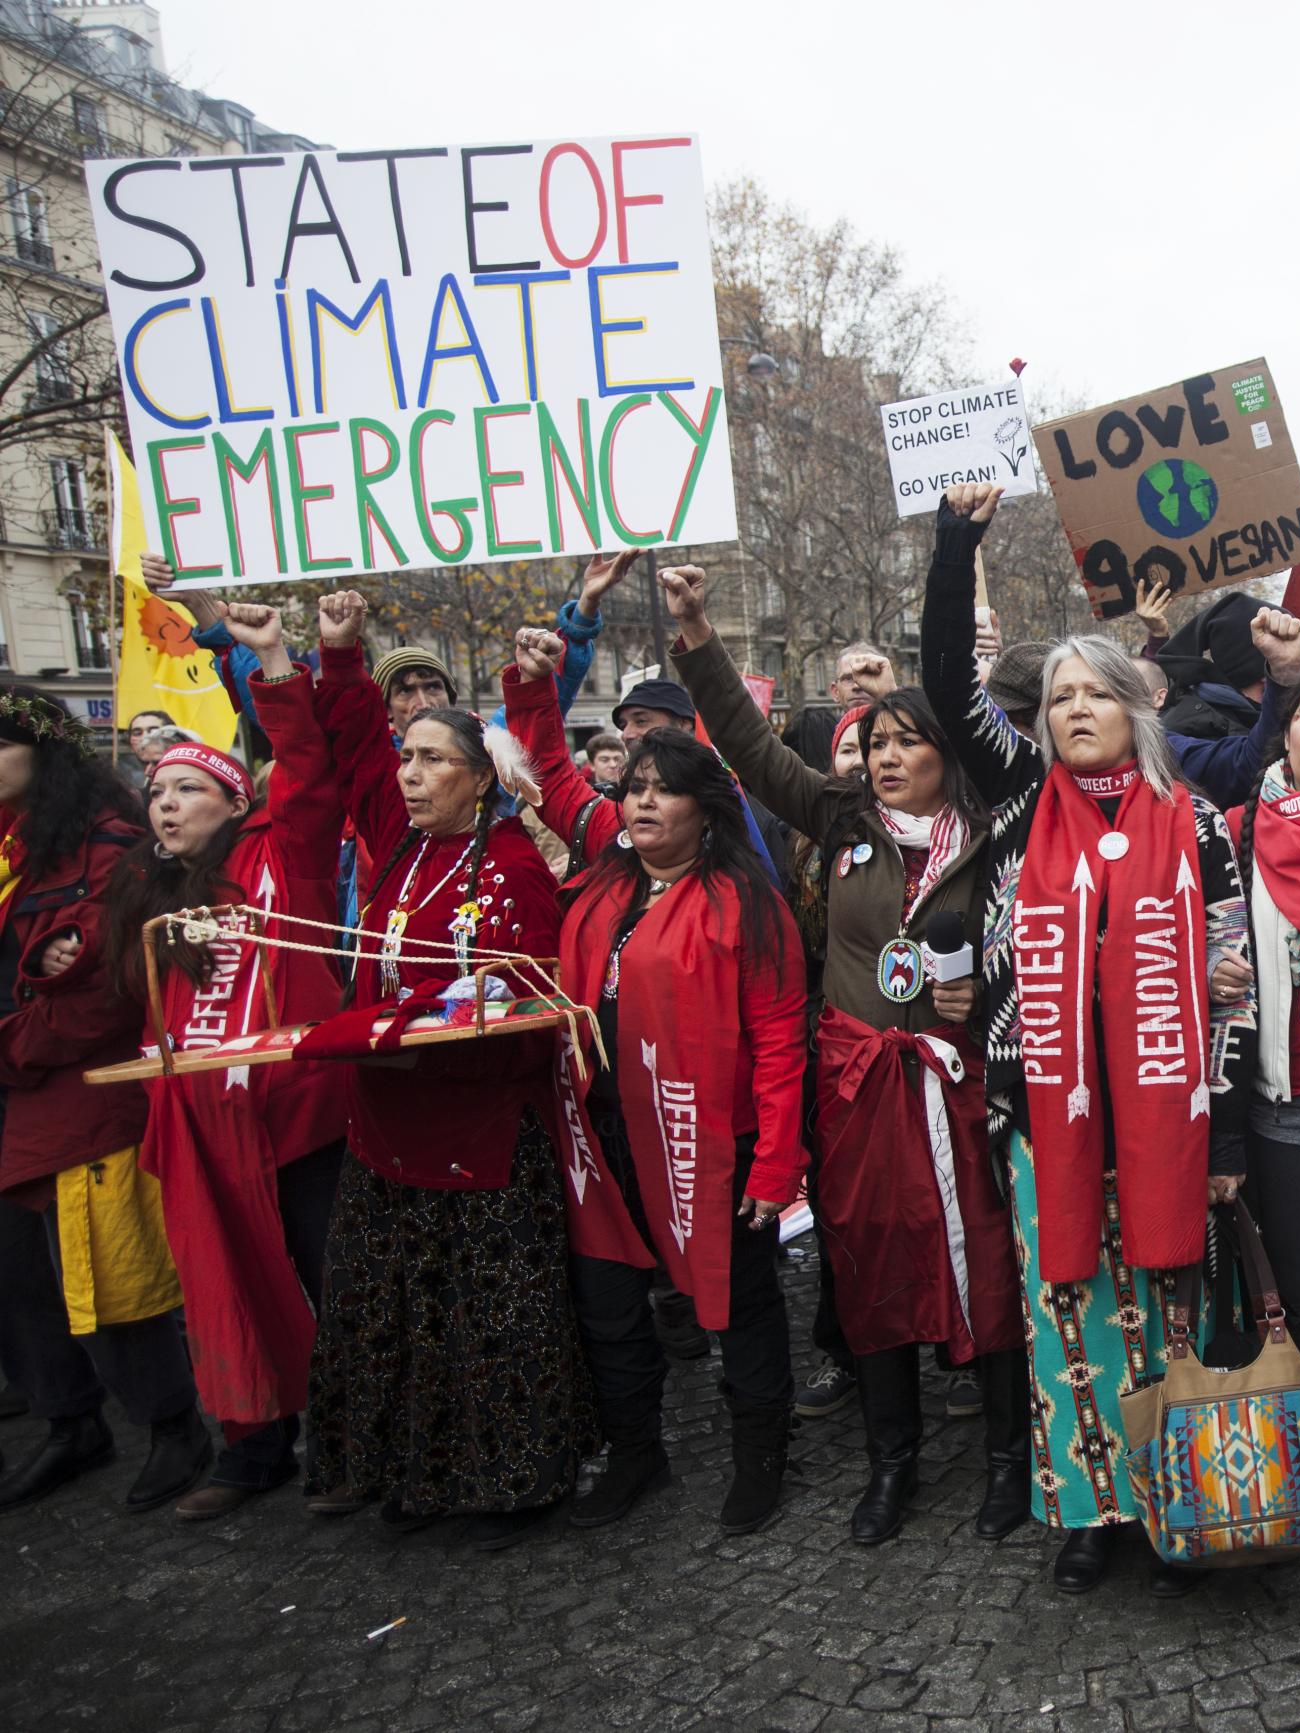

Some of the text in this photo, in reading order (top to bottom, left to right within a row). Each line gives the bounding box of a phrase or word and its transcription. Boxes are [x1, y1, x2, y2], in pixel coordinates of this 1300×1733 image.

[103, 137, 692, 291] STATE OF
[1231, 375, 1263, 389] CLIMATE
[1234, 382, 1265, 397] JUSTICE
[1243, 391, 1259, 400] FOR
[888, 389, 1018, 429] STOP CLIMATE
[1240, 396, 1265, 408] PEACE
[891, 422, 970, 451] CHANGE!
[1054, 373, 1230, 481] LOVE
[147, 386, 723, 581] EMERGENCY
[899, 465, 997, 497] GO VEGAN!
[207, 754, 242, 783] RENEW
[1014, 899, 1065, 1085] PROTECT
[1134, 896, 1188, 1086] RENOVAR
